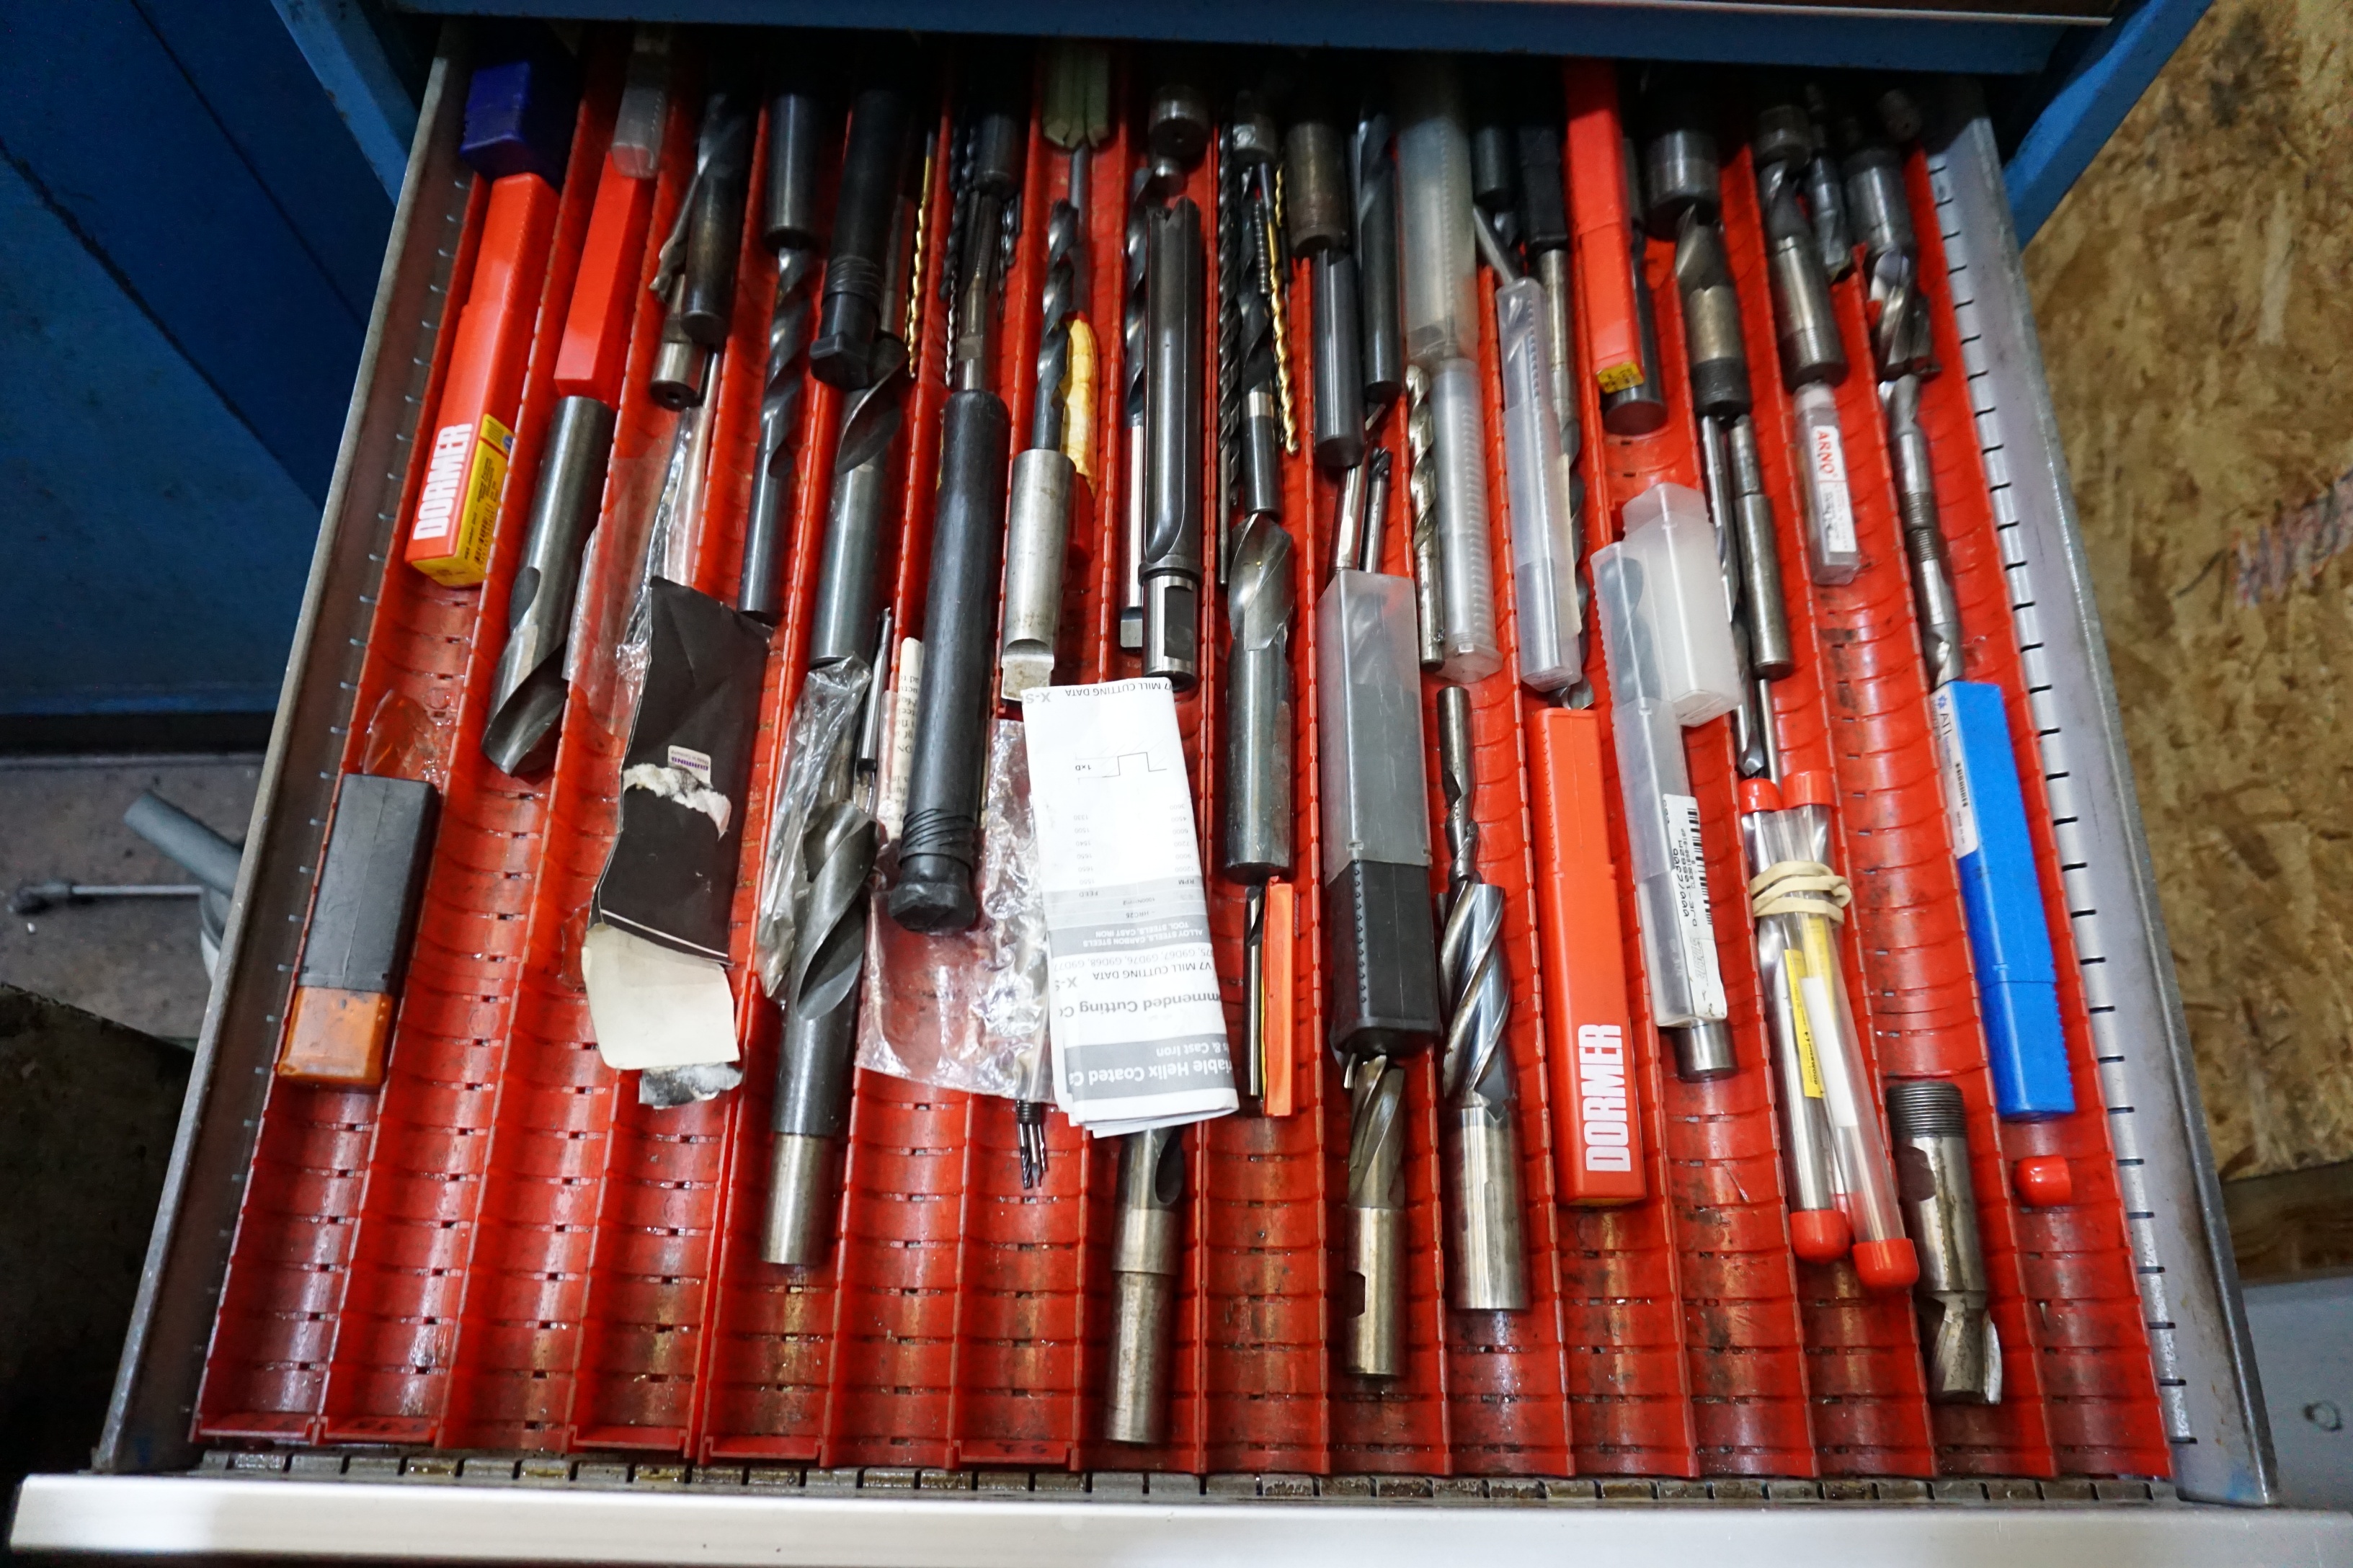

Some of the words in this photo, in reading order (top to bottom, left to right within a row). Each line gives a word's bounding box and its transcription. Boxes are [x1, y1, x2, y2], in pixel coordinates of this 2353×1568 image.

[413, 423, 473, 540] DORMER
[1064, 687, 1090, 697] DATA
[1093, 683, 1137, 696] CUTTING
[1138, 682, 1161, 691] MILL
[1095, 930, 1114, 939] IRON
[1114, 928, 1137, 937] CAST
[1177, 928, 1204, 937] ALLOY
[1082, 938, 1113, 948] STEELS
[1113, 936, 1146, 945] CARBON
[1170, 962, 1196, 973] MILL
[1199, 961, 1212, 971] V7
[1092, 971, 1119, 981] DATA
[1122, 966, 1169, 979] CUTTING
[1079, 1000, 1139, 1015] Cutting
[1155, 1046, 1182, 1058] Iron
[1183, 1042, 1211, 1054] Cast
[1211, 1042, 1222, 1054] &
[1148, 1061, 1190, 1080] Helix
[1087, 1066, 1145, 1087] Coated
[1578, 1024, 1632, 1172] DORMER
